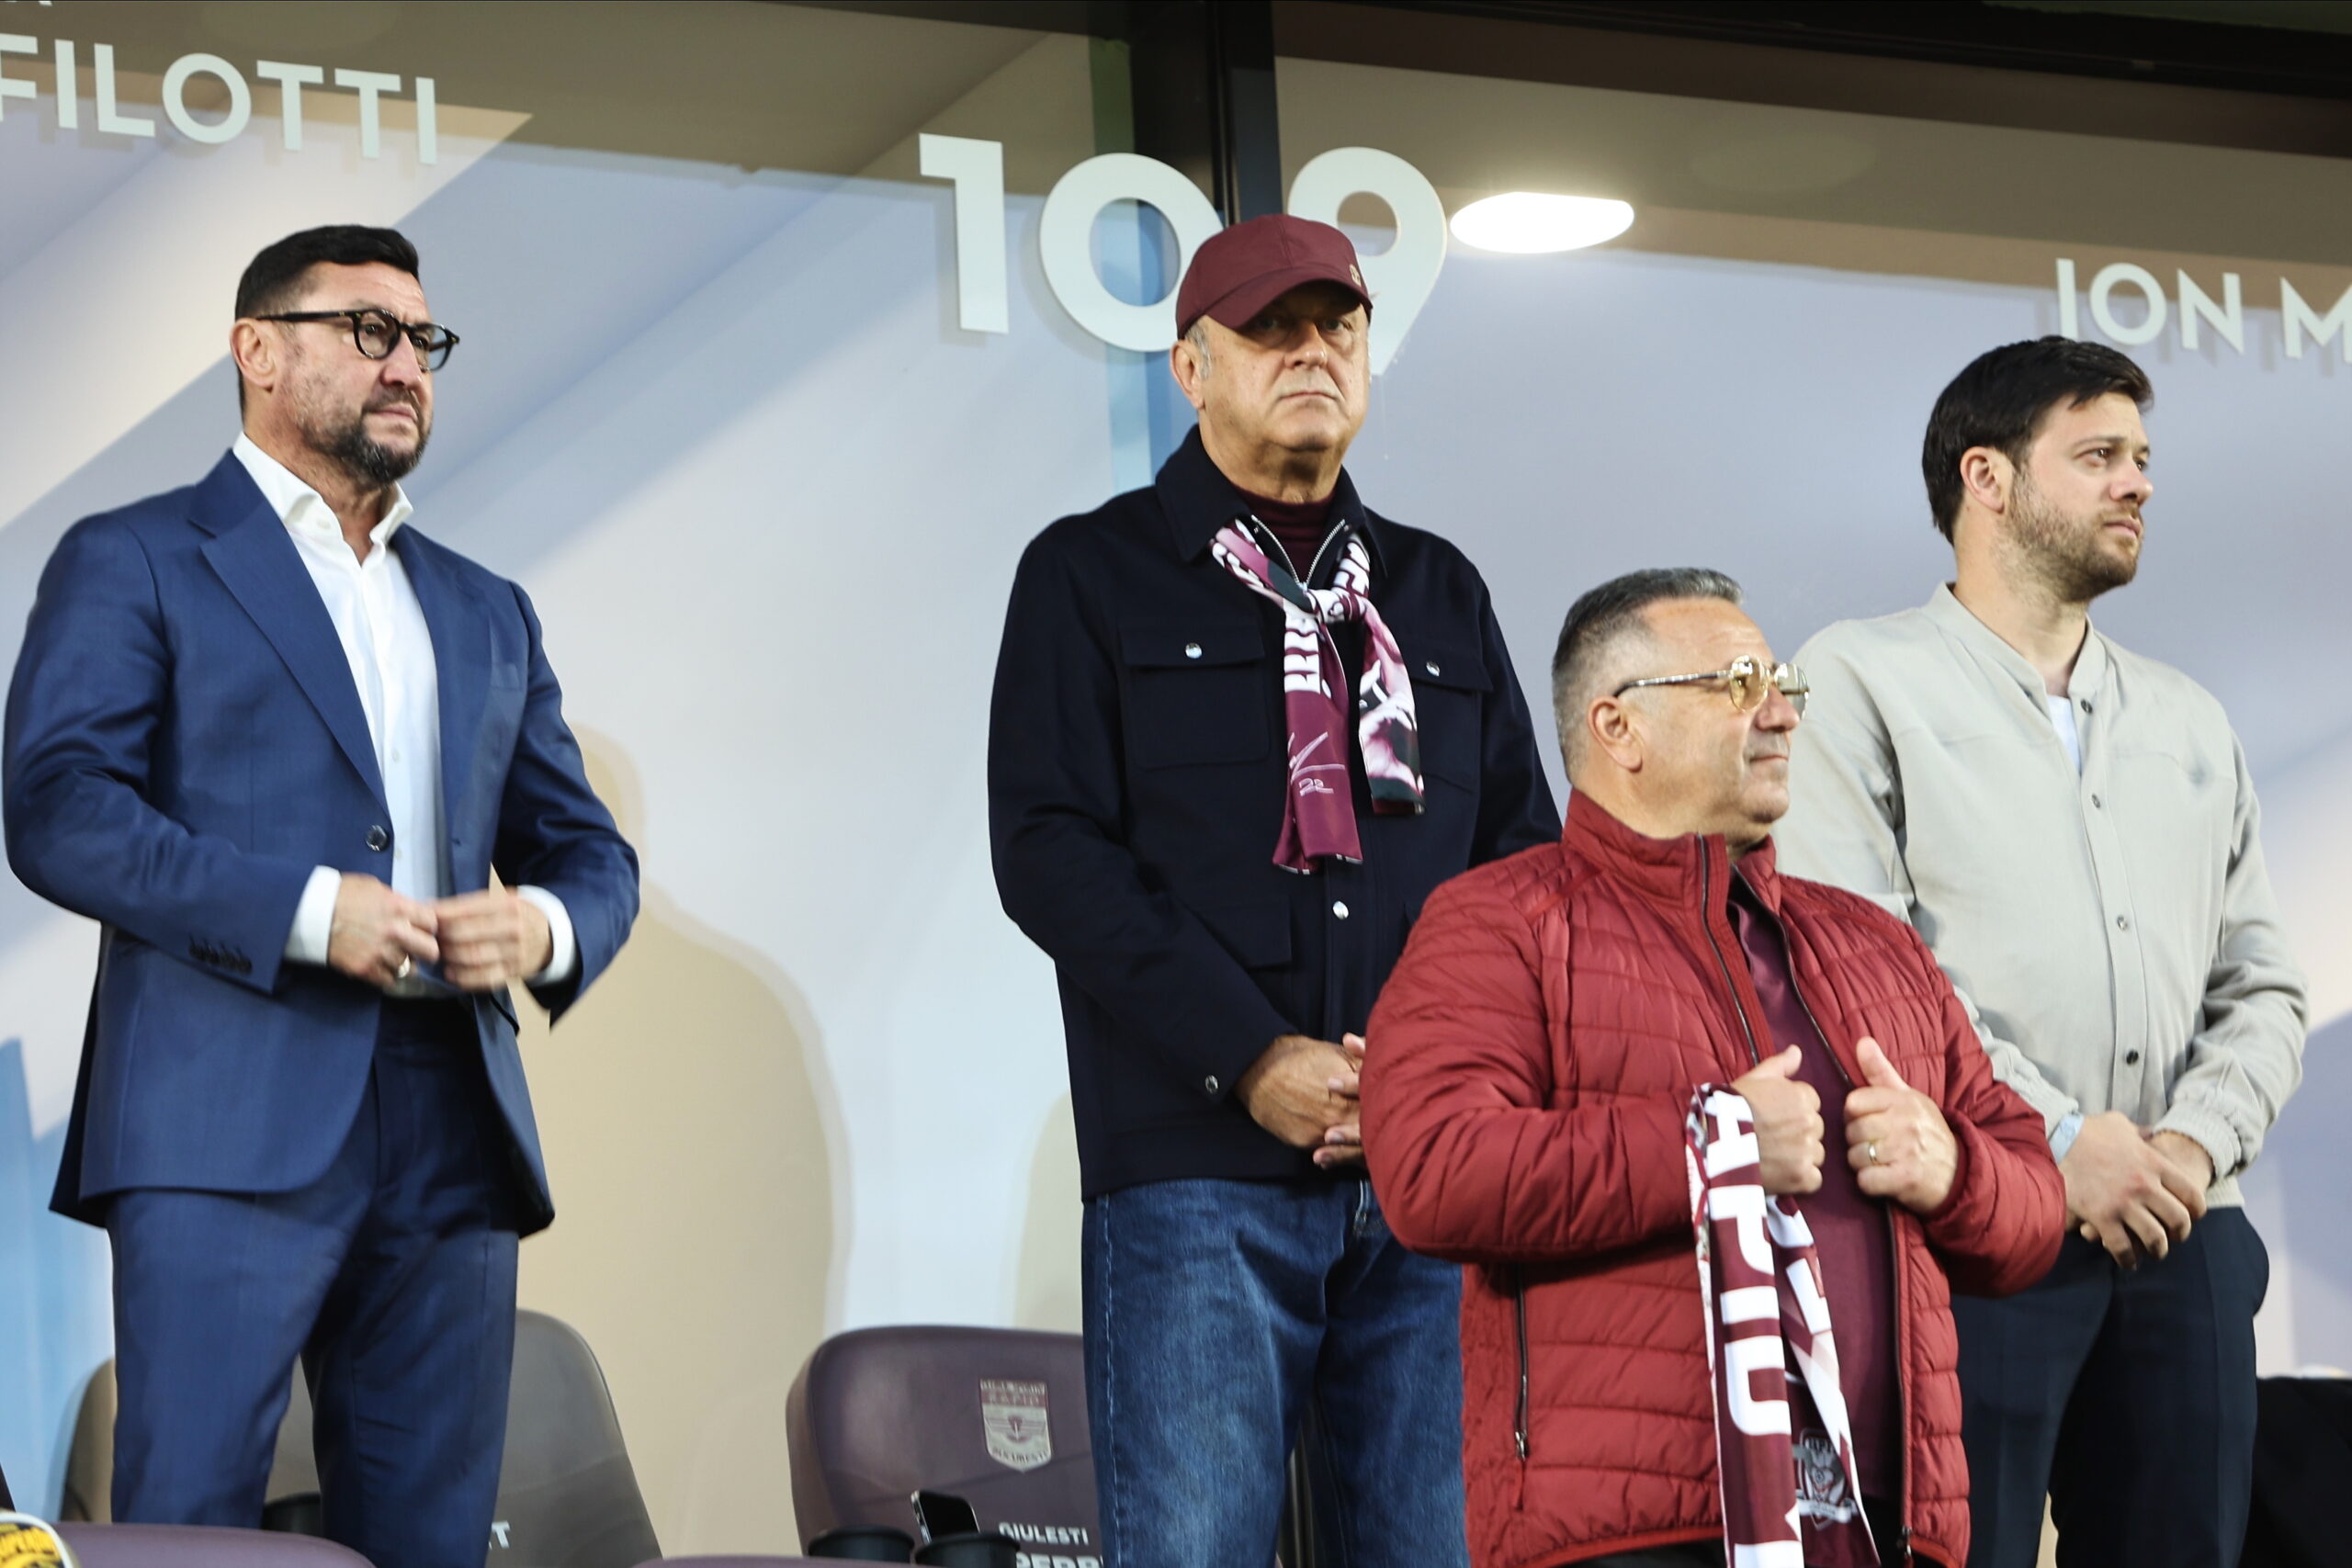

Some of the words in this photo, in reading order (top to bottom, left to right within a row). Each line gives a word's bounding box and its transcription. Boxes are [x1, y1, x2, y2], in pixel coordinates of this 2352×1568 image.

[0, 33, 437, 165] FILOTTI
[919, 132, 1447, 376] 109
[2056, 258, 2245, 355] ION
